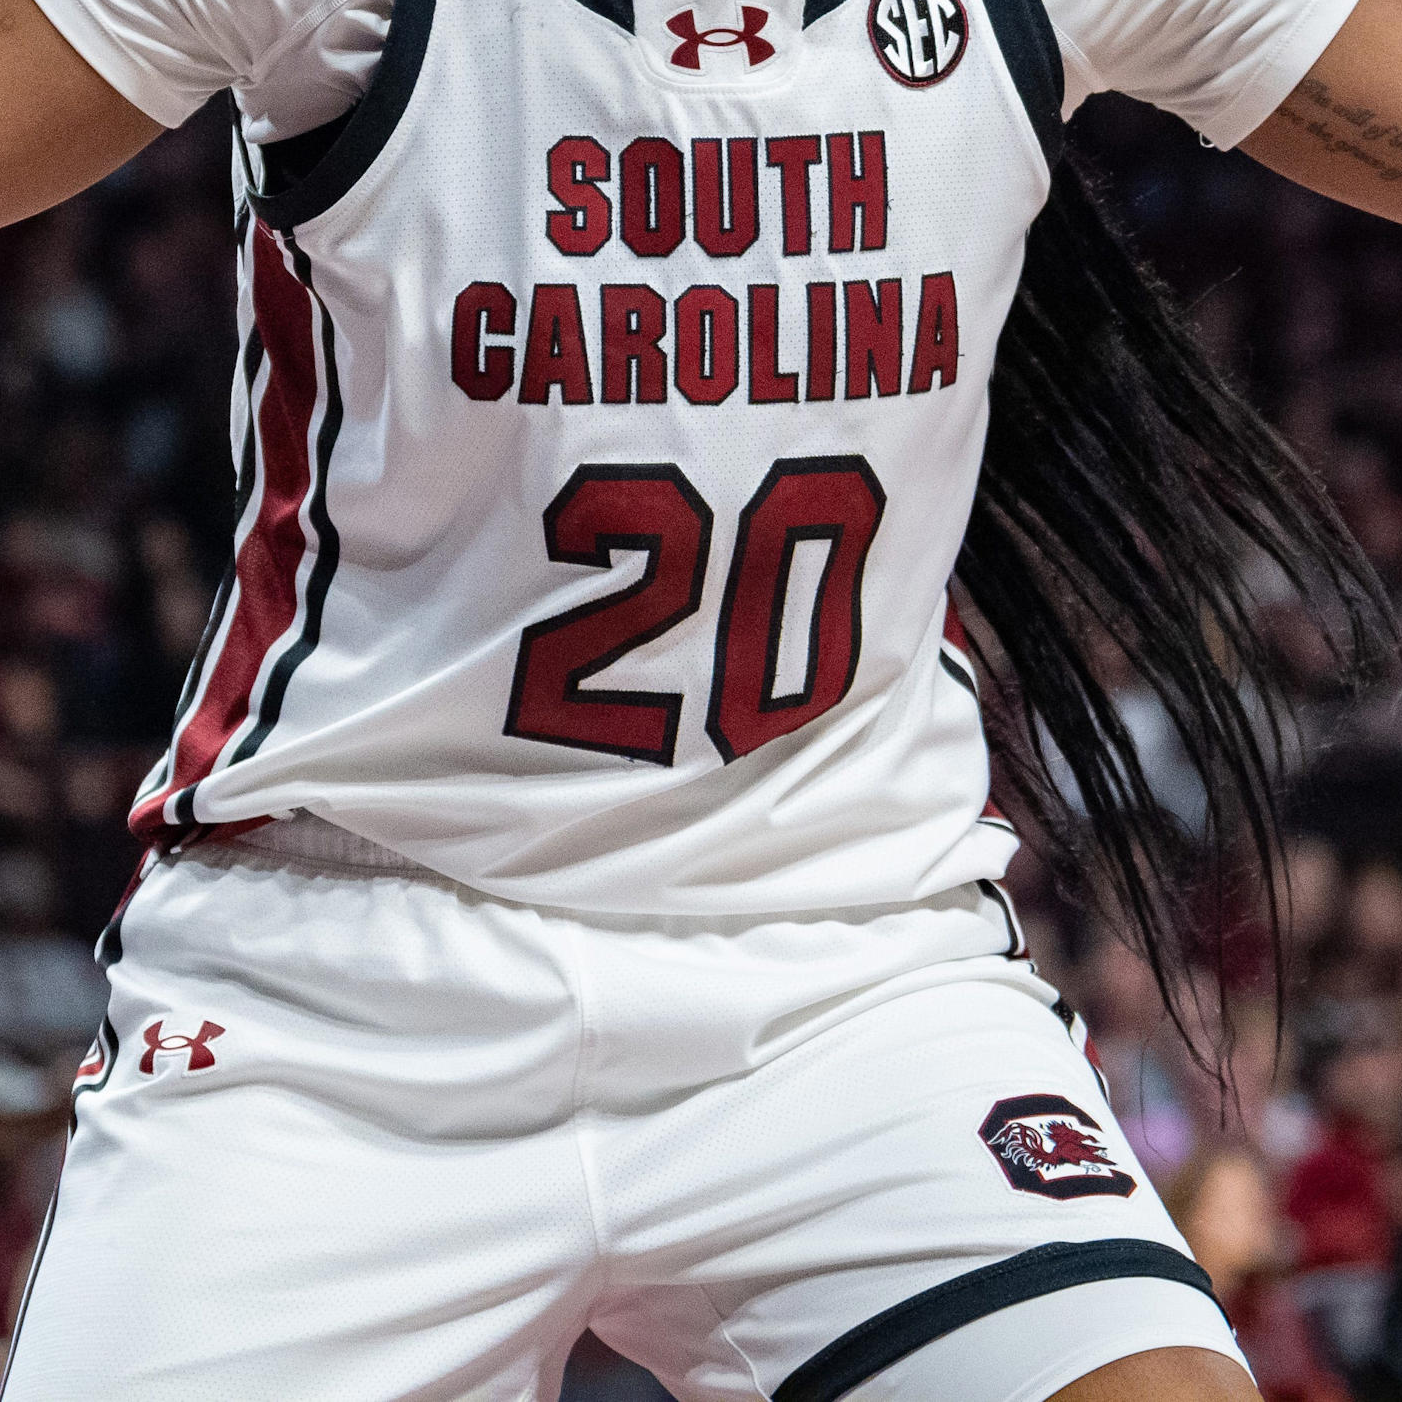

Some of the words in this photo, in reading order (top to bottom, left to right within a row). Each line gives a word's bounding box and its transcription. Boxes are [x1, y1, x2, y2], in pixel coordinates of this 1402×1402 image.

[545, 130, 889, 258] SOUTH
[450, 270, 961, 406] CAROLINA
[502, 454, 887, 768] 20
